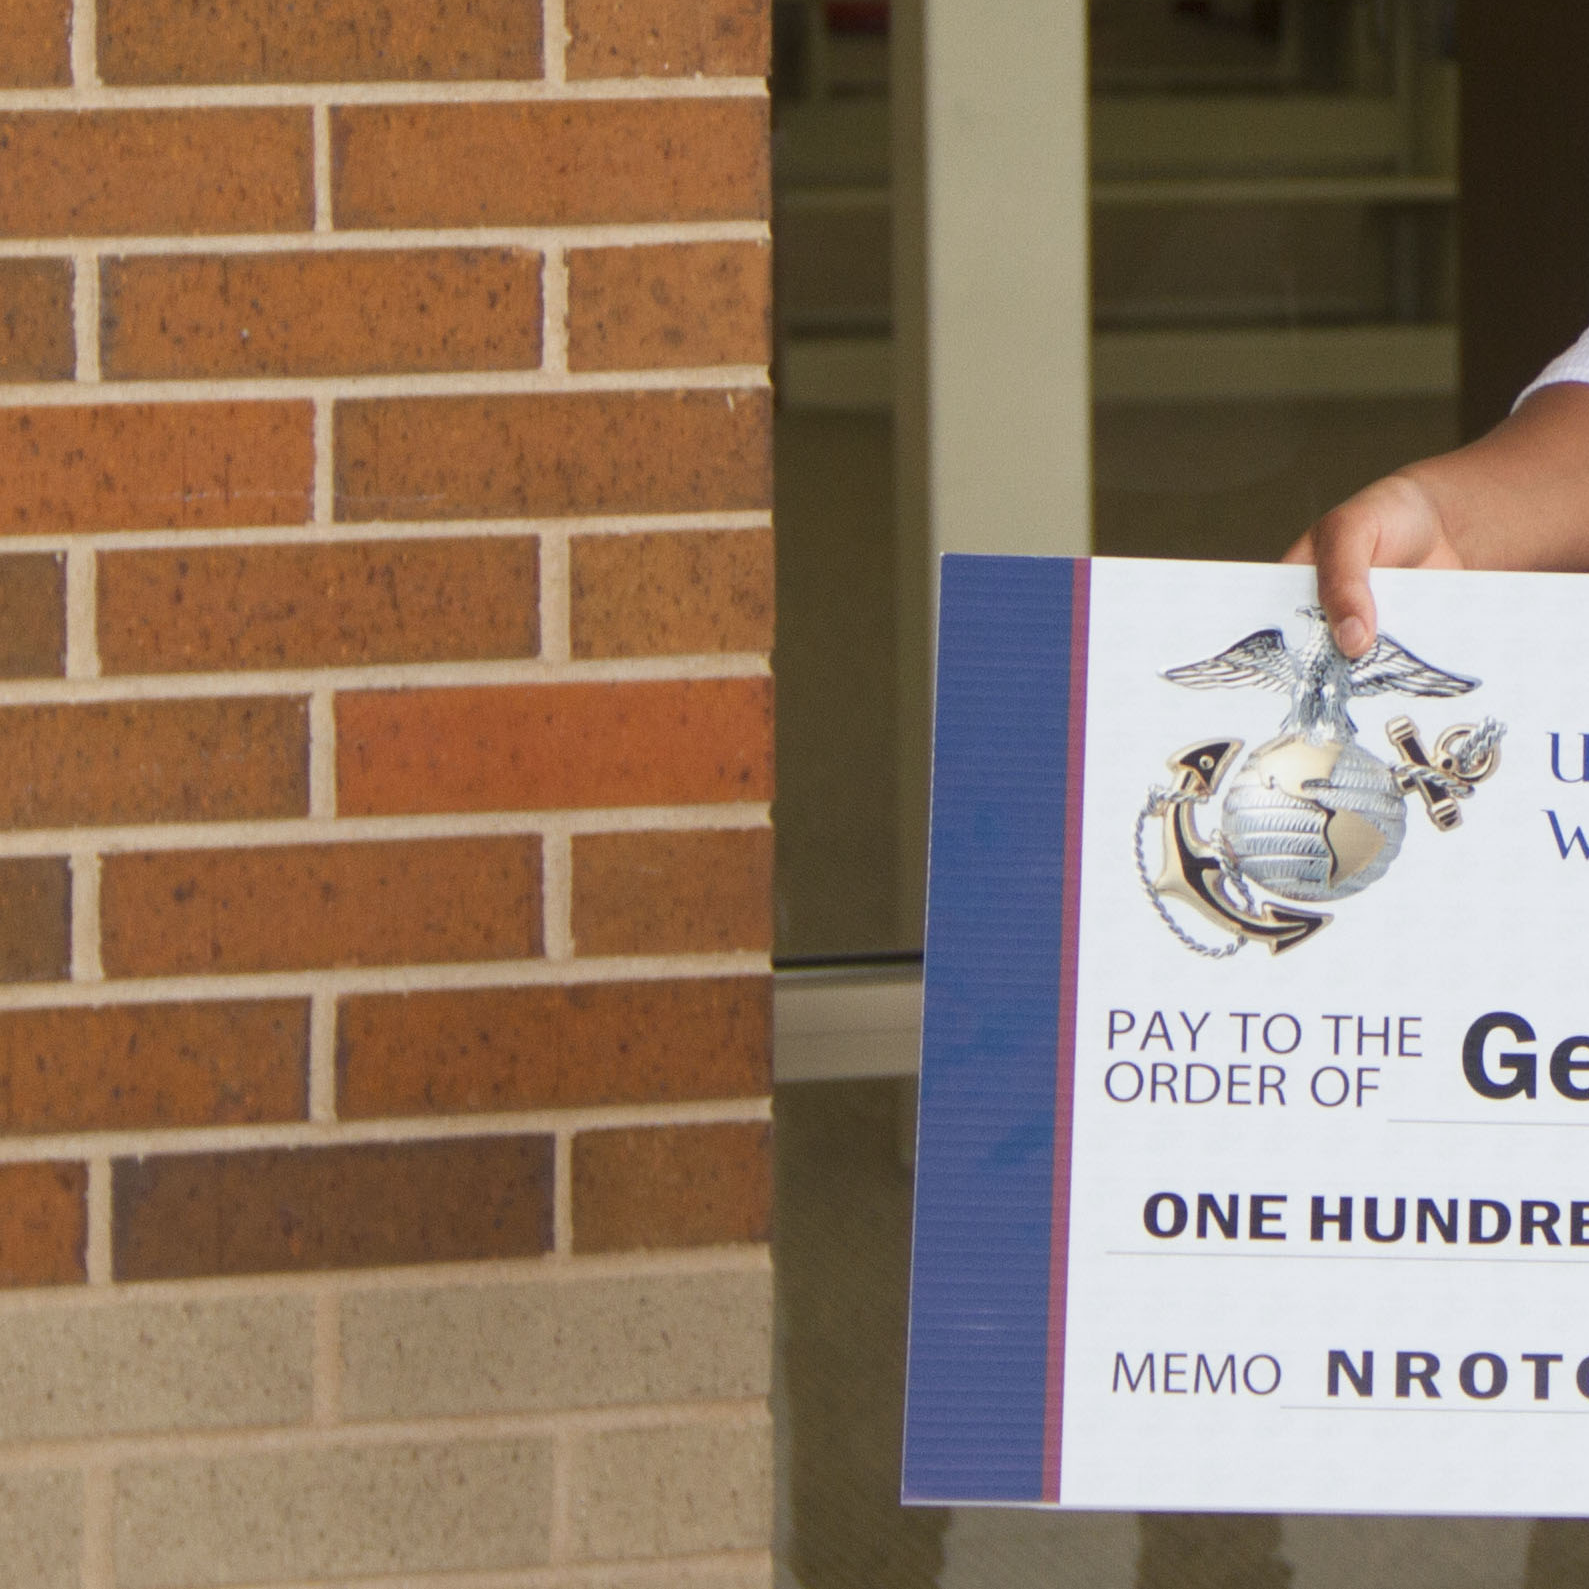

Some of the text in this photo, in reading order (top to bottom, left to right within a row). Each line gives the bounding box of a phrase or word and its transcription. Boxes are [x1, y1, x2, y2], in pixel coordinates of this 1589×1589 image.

[1107, 1009, 1423, 1060] PAY TO THE
[1103, 1060, 1381, 1109] ORDER OF
[1142, 1191, 1288, 1242] ONE
[1111, 1351, 1282, 1396] MEMO
